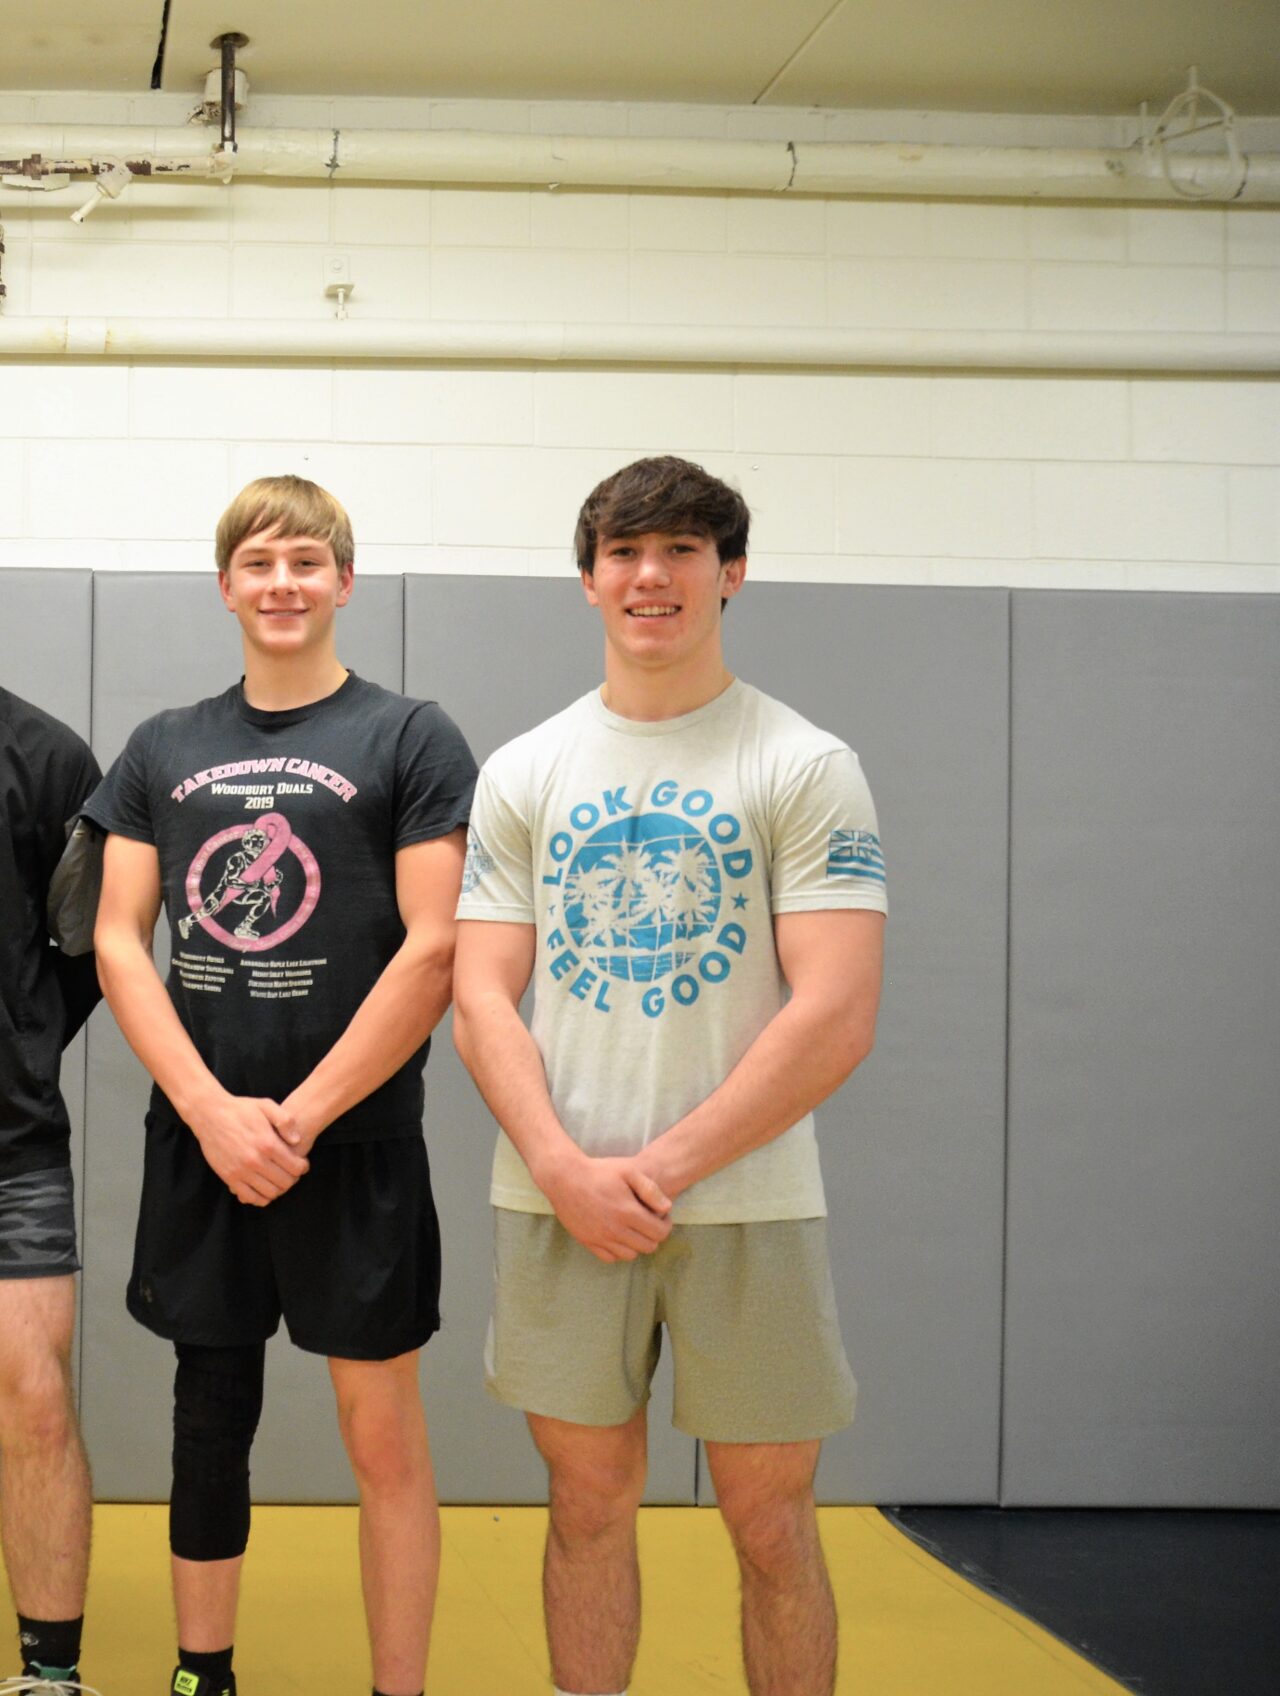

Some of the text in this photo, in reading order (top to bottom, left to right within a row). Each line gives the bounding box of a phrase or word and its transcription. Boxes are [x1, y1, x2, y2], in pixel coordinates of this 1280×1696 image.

[170, 757, 358, 804] TAKEDOWN CANCER
[211, 782, 314, 796] WOODBURY DUALS
[244, 796, 275, 809] 2019
[542, 780, 753, 886] LOOK GOOD
[547, 922, 747, 1019] FEEL GOOD
